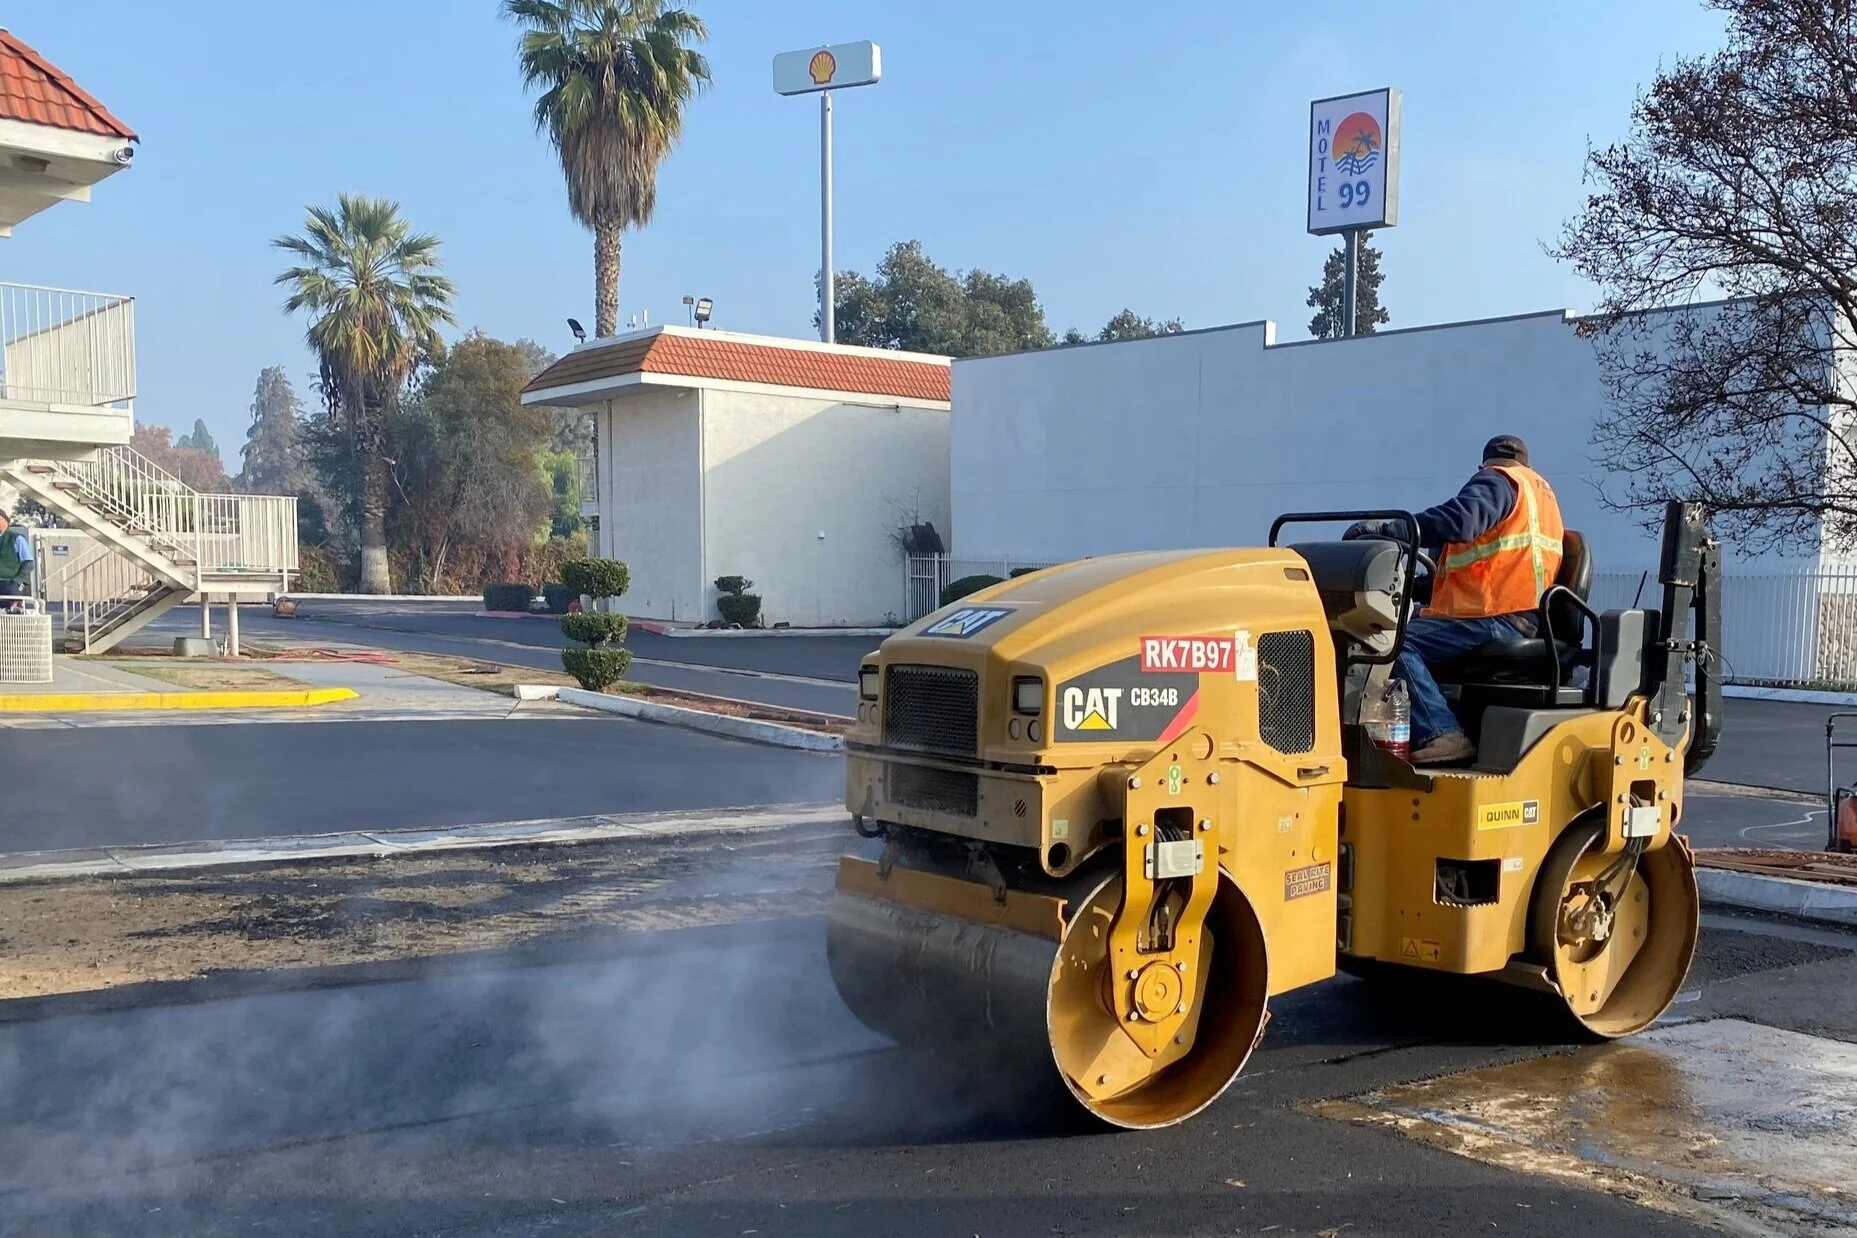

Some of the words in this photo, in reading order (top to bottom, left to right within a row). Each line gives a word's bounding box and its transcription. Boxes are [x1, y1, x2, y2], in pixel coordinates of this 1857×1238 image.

[1317, 119, 1330, 211] MOTEL
[1339, 180, 1370, 209] 99
[927, 609, 1008, 635] CAT
[1145, 639, 1232, 668] RK7B97
[1063, 686, 1122, 730] CAT
[1130, 687, 1178, 706] CB34B
[1486, 809, 1520, 822] QUINN
[1524, 806, 1537, 818] CAT
[1290, 878, 1324, 897] PAVING
